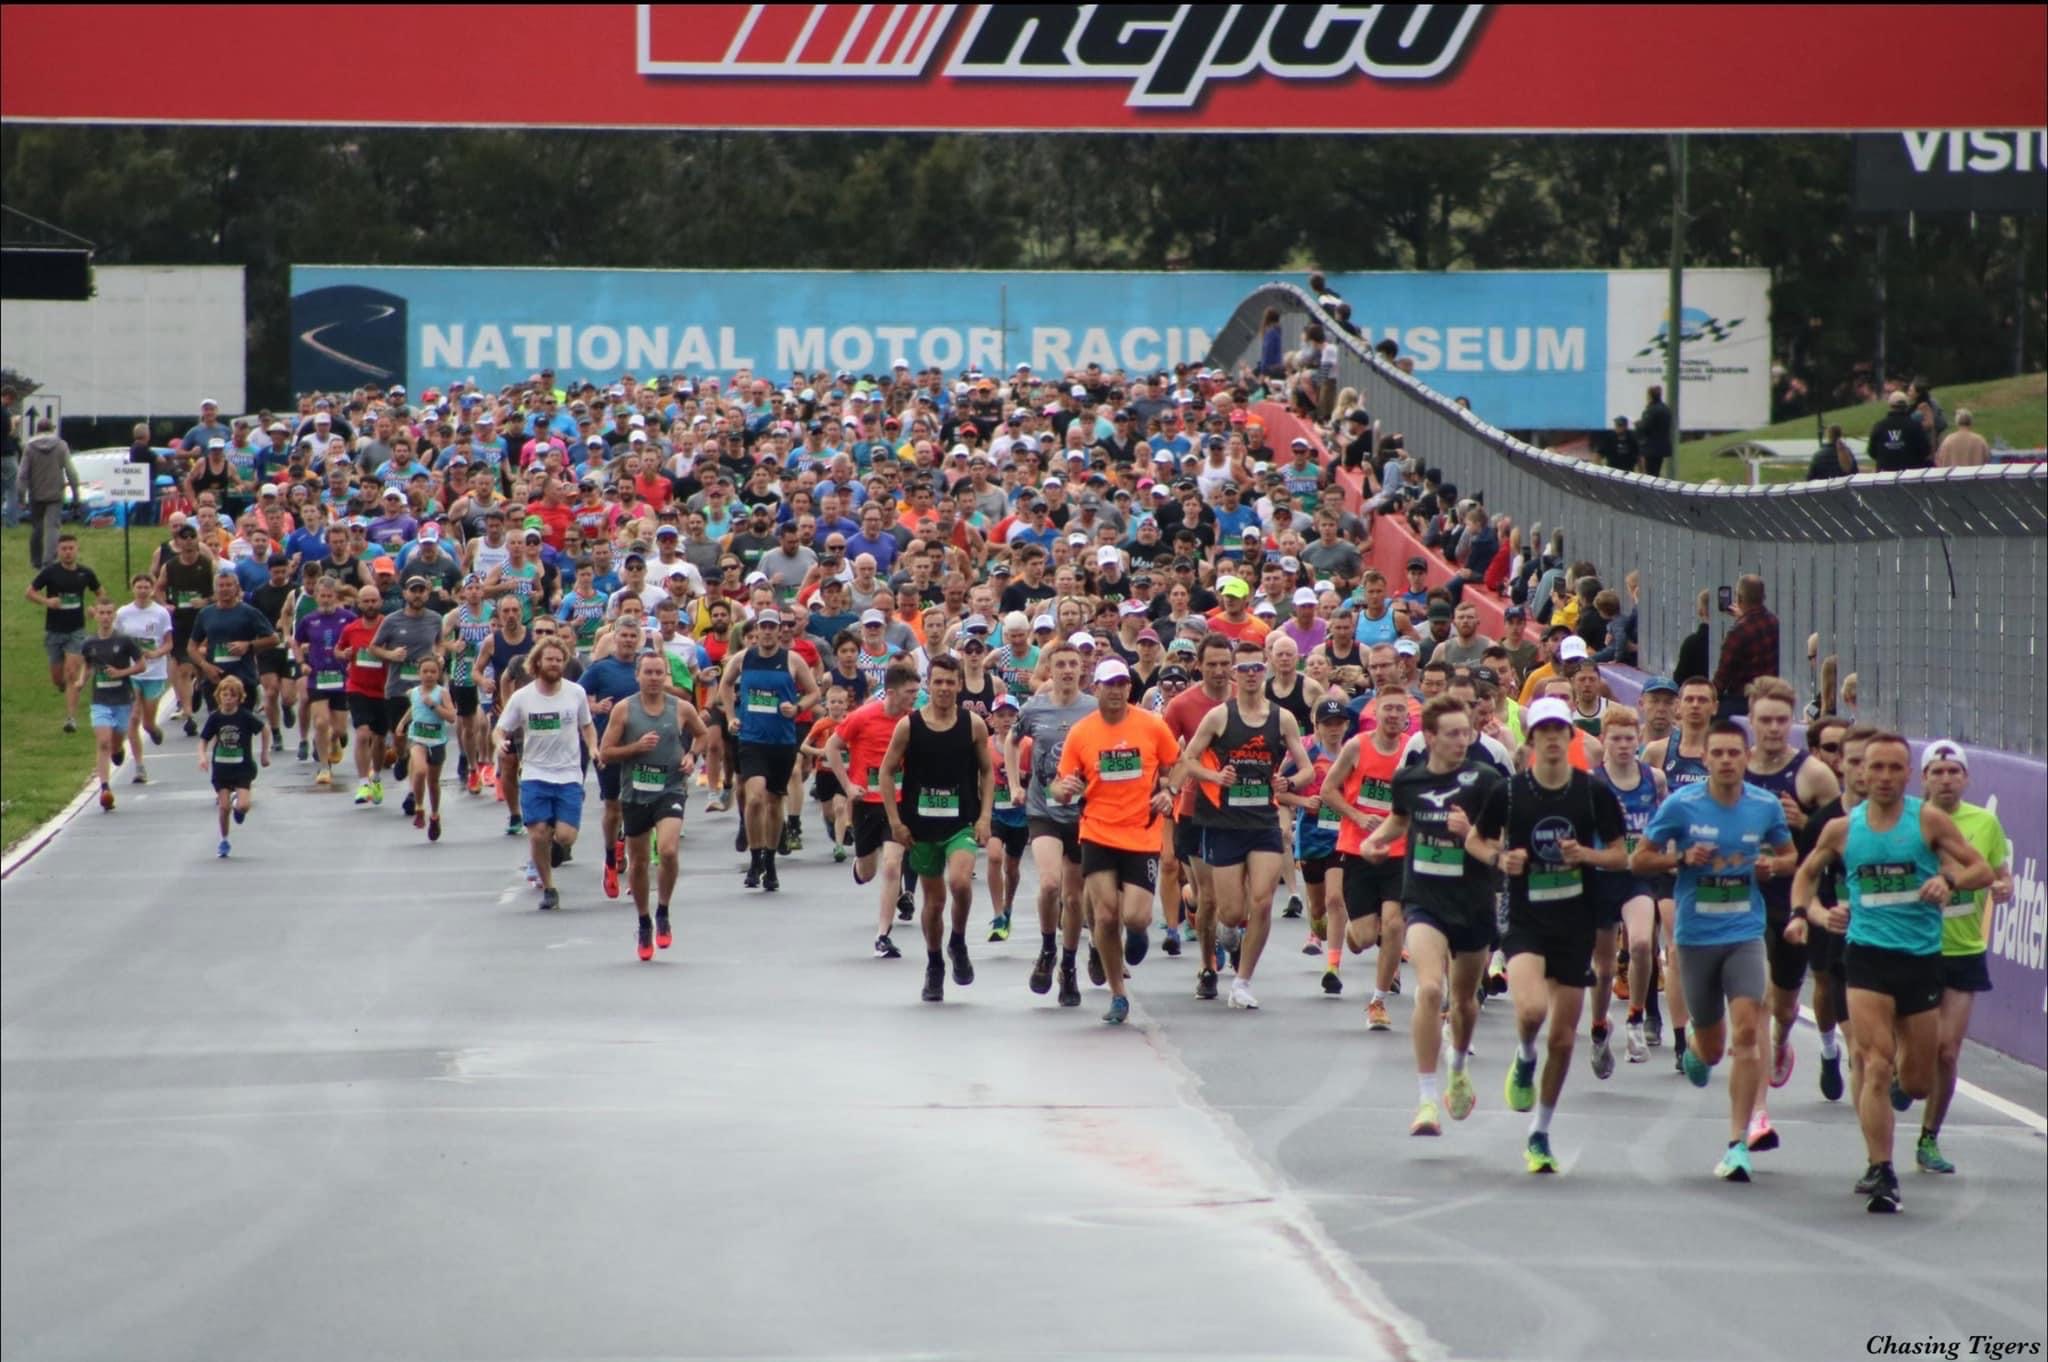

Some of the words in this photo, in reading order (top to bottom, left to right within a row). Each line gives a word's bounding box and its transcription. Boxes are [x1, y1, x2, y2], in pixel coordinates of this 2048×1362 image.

[1902, 130, 2047, 172] VISI
[420, 324, 754, 370] NATIONAL
[777, 325, 1006, 371] MOTOR
[1031, 326, 1214, 372] RACIN
[1366, 326, 1585, 372] SEUM
[1107, 759, 1134, 772] 256
[1432, 850, 1442, 863] 2
[1874, 877, 1907, 892] 323
